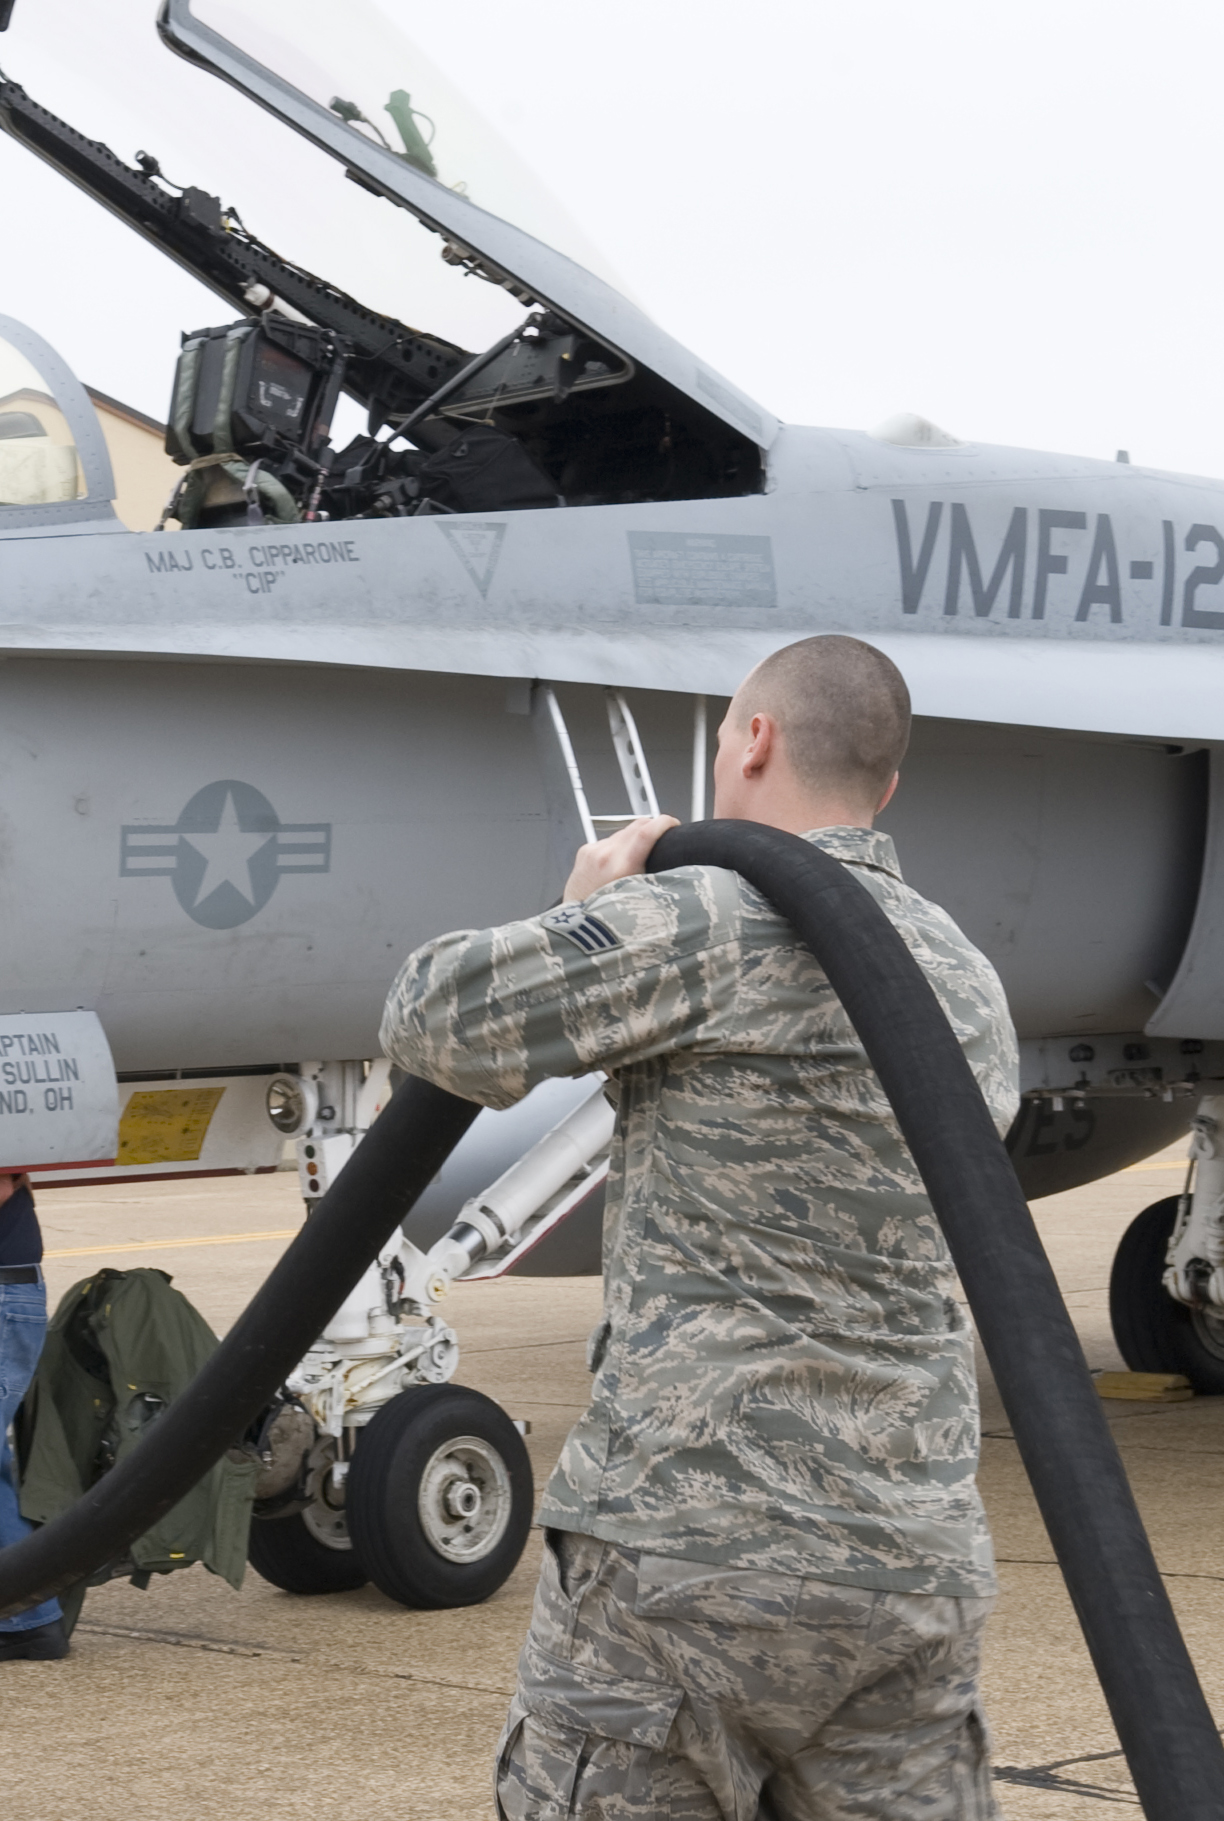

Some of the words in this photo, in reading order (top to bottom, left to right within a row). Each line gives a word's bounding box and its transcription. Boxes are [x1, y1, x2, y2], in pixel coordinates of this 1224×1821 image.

[145, 550, 194, 573] MAJ
[201, 547, 242, 570] C.B.
[249, 540, 360, 567] CIPPARONE
[891, 499, 1224, 630] VMFA-12
[233, 570, 285, 594] "CIP"
[2, 1058, 80, 1085] SULLIN
[44, 1086, 74, 1112] OH
